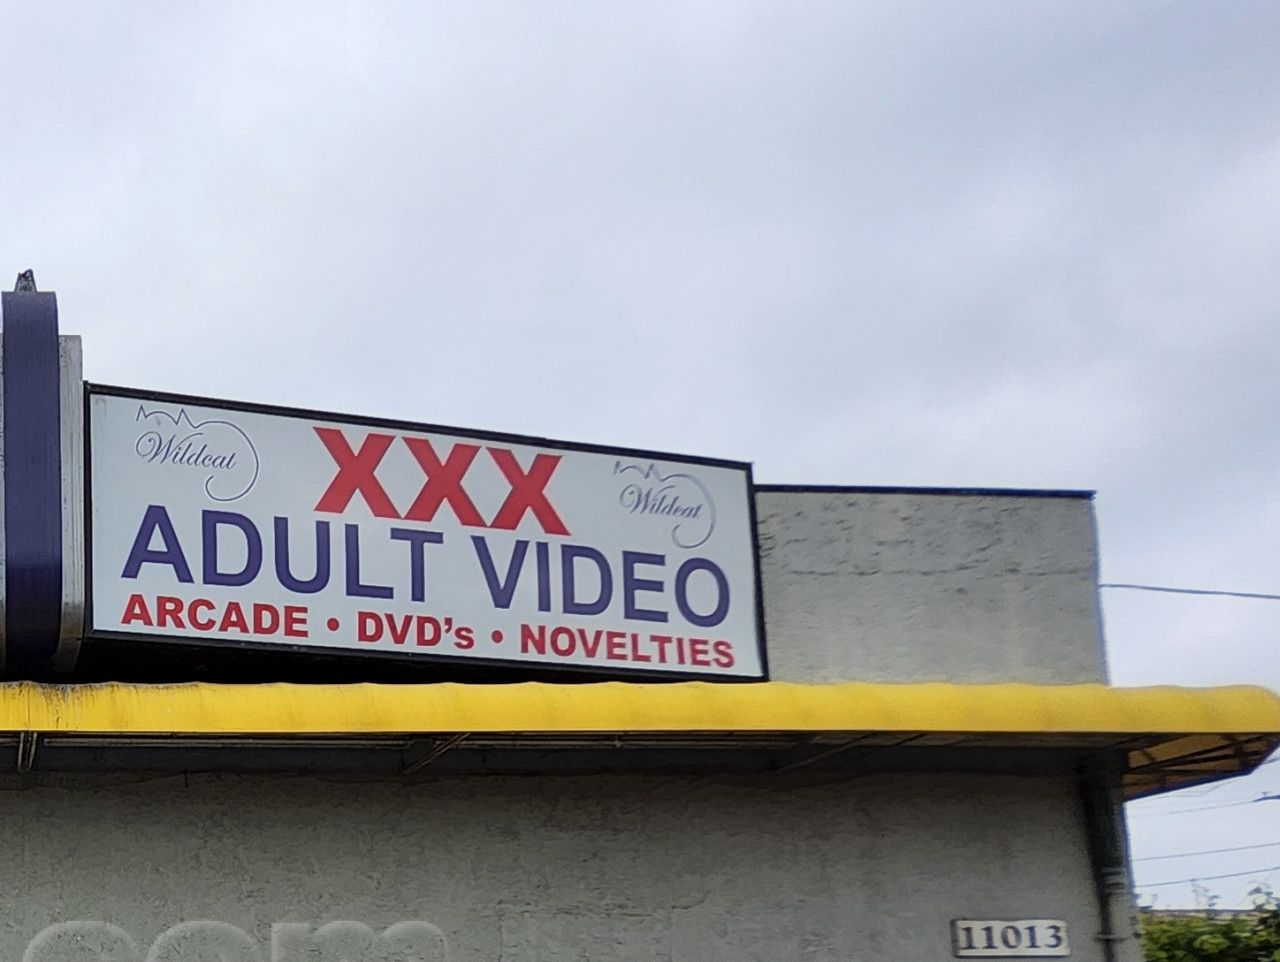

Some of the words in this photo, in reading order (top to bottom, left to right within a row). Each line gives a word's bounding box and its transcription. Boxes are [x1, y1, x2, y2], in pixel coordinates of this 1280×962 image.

[135, 431, 237, 470] Wildcat
[314, 427, 571, 536] XXX
[619, 484, 703, 519] Wildcat
[120, 504, 444, 603] ADULT
[471, 535, 731, 628] VIDEO
[121, 594, 308, 639] ARCADE
[356, 611, 475, 650] DVD's
[520, 623, 735, 668] NOVELTIES
[959, 925, 1063, 950] 11013
